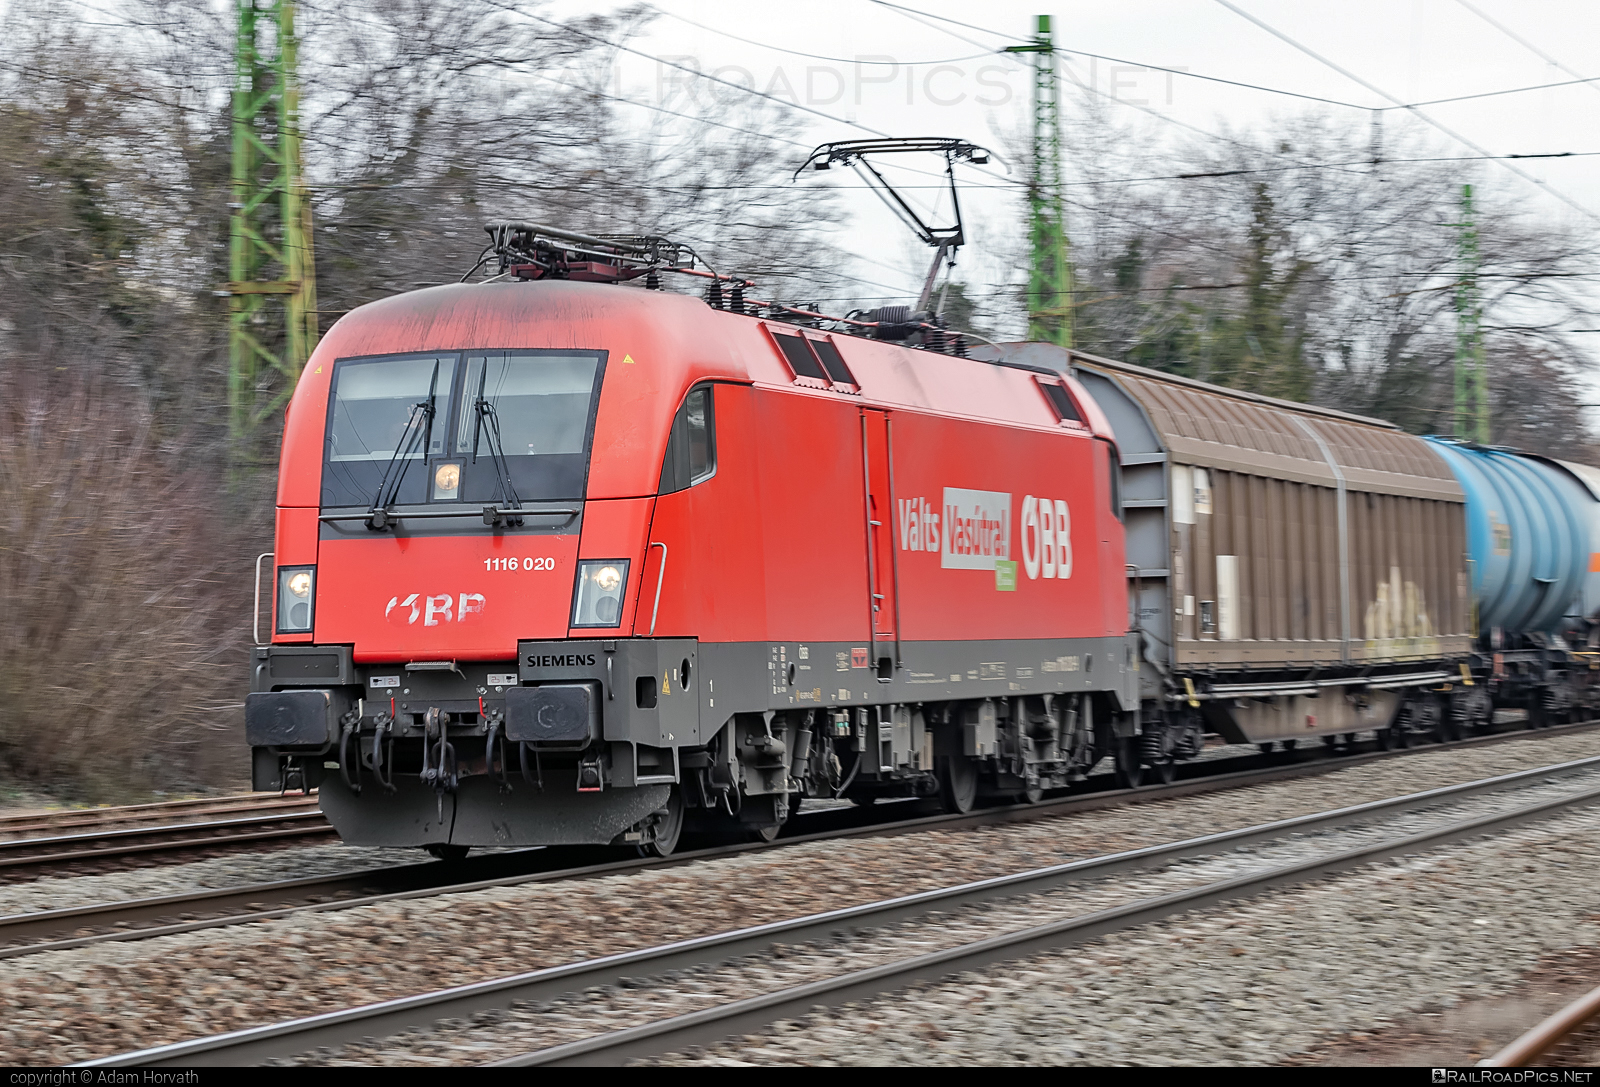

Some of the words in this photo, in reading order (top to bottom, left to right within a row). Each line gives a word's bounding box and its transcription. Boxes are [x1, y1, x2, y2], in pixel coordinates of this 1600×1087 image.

[898, 497, 940, 552] Válts
[1021, 494, 1072, 580] ÖBB
[483, 557, 518, 571] 1116
[523, 557, 555, 571] 020
[527, 653, 596, 668] SIEMENS
